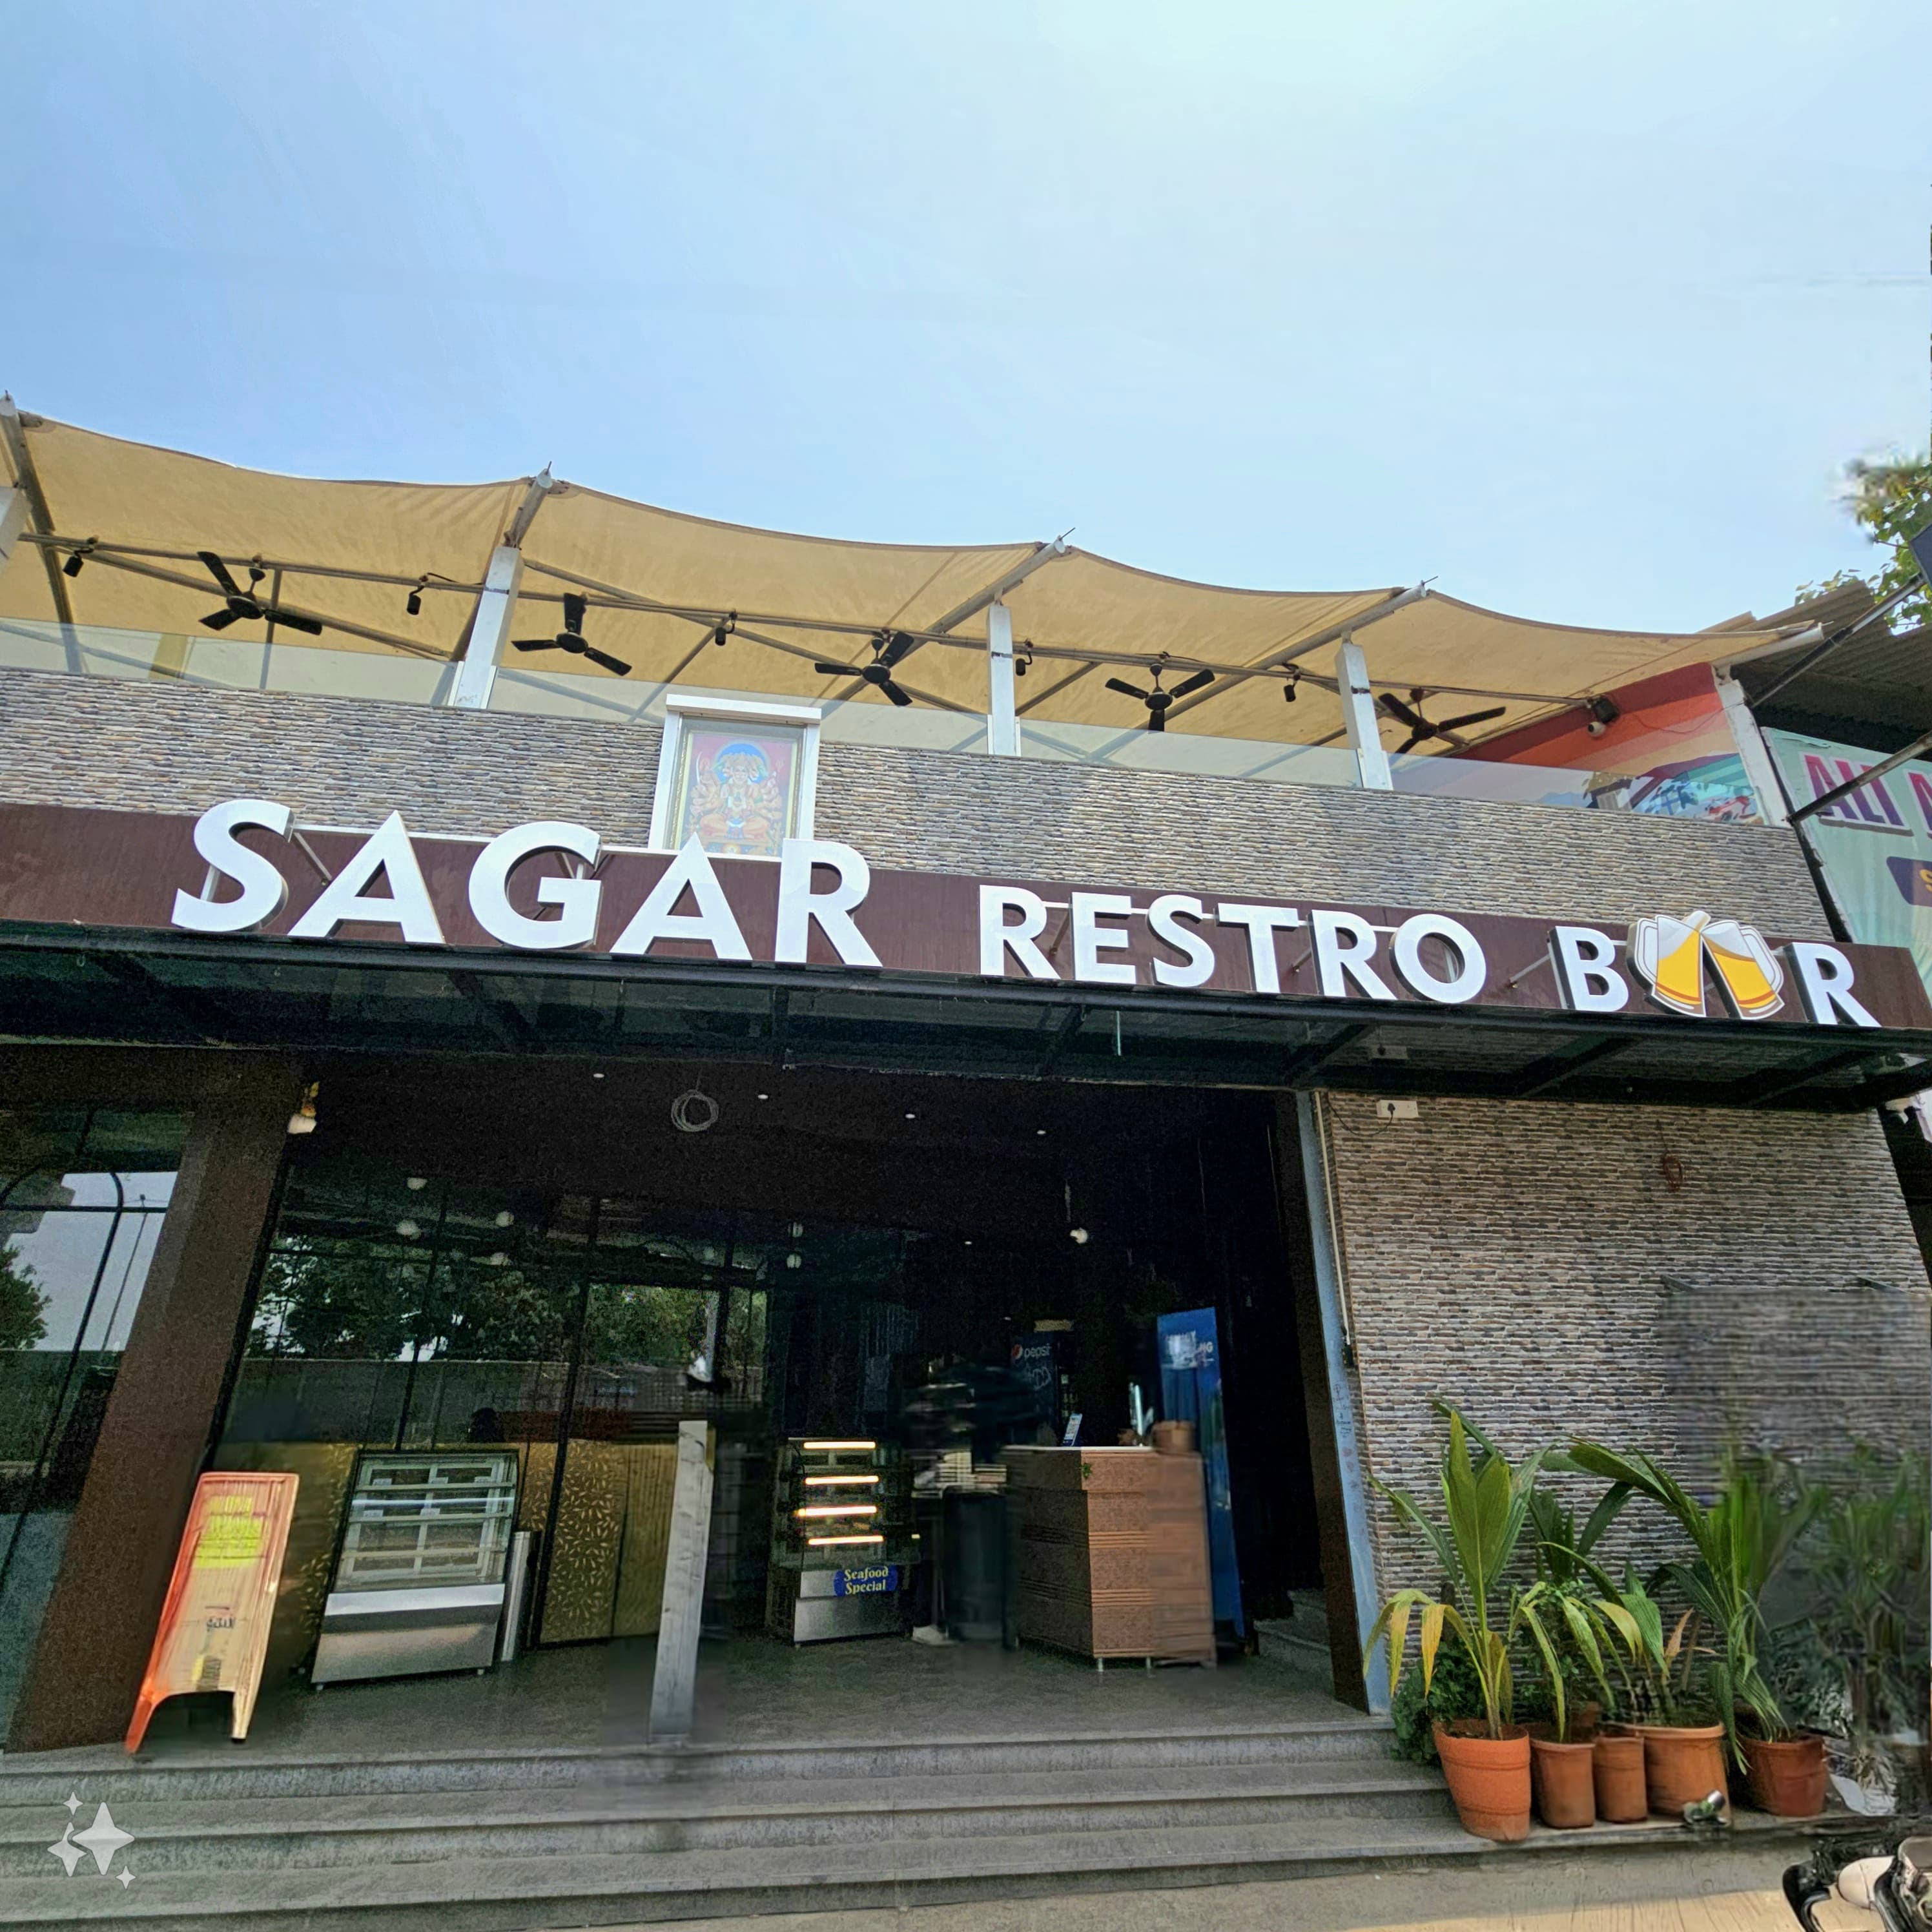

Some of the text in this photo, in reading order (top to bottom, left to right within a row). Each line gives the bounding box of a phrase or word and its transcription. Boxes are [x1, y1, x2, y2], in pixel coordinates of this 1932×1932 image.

[171, 799, 883, 968] SAGAR
[978, 884, 1487, 1003] RESTRO
[843, 1565, 889, 1582] Seafood
[845, 1579, 886, 1595] Special
